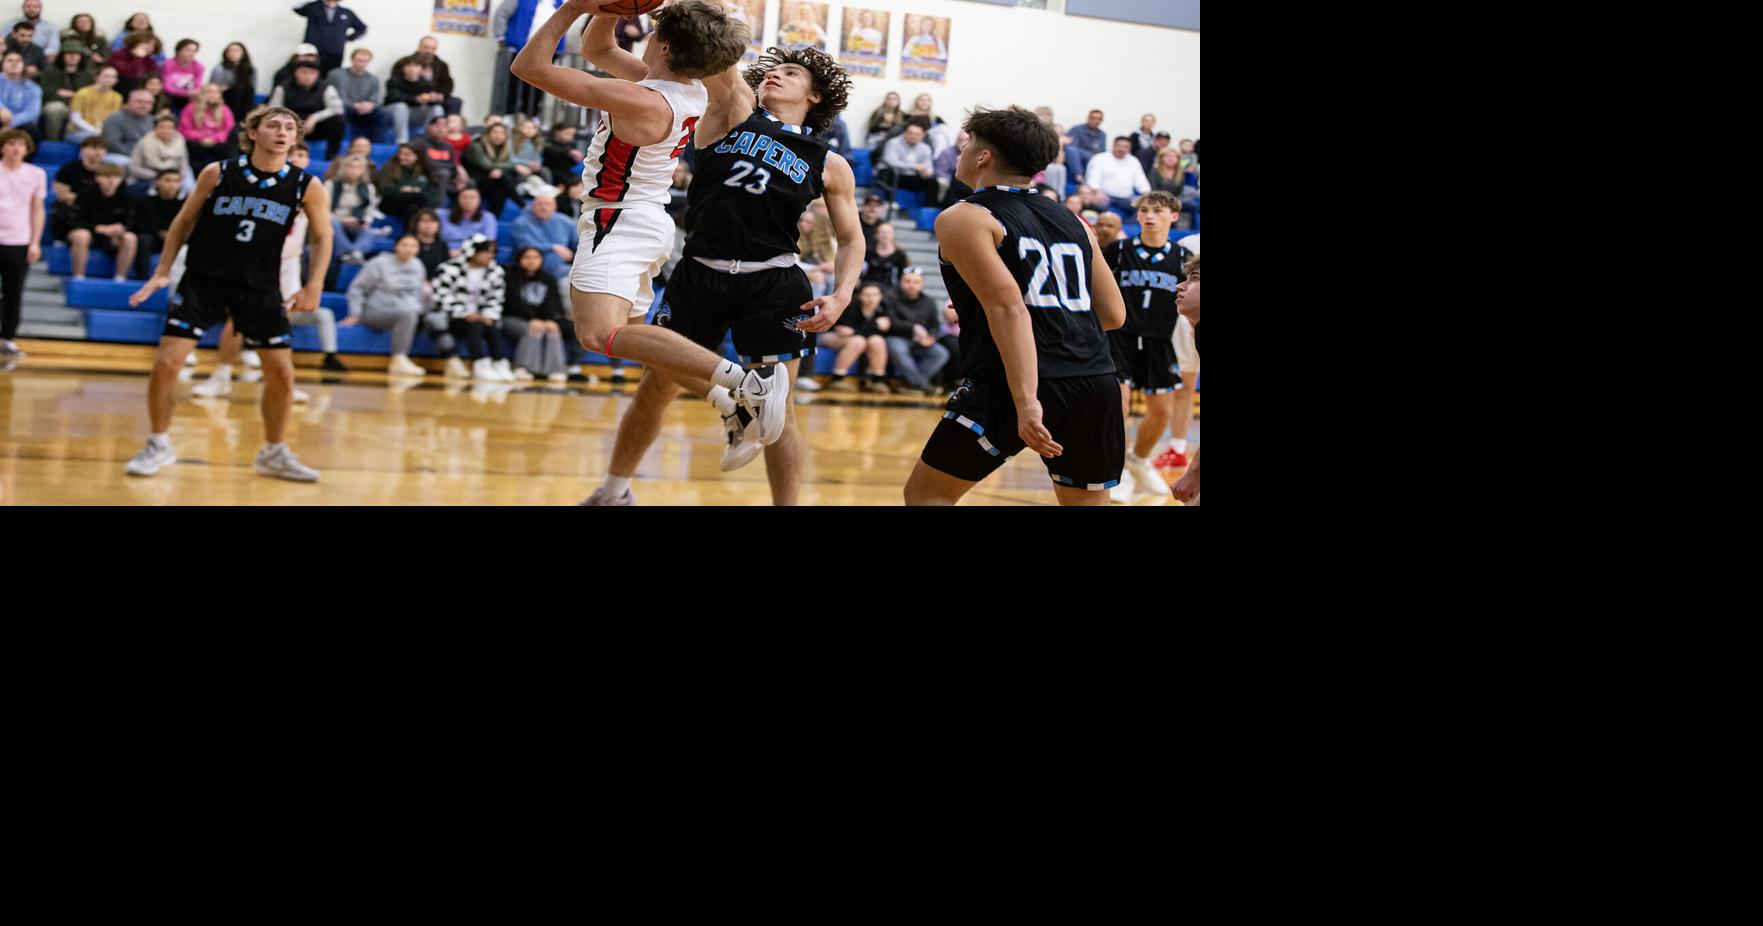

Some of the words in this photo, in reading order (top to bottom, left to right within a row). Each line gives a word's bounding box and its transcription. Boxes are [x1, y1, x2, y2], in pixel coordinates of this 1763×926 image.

[714, 131, 810, 184] CAPERS
[723, 160, 771, 195] 23
[213, 196, 291, 226] CAPERS
[235, 220, 256, 243] 3
[1018, 236, 1091, 312] 20
[1120, 270, 1178, 293] CAPERS
[1142, 289, 1152, 309] 1
